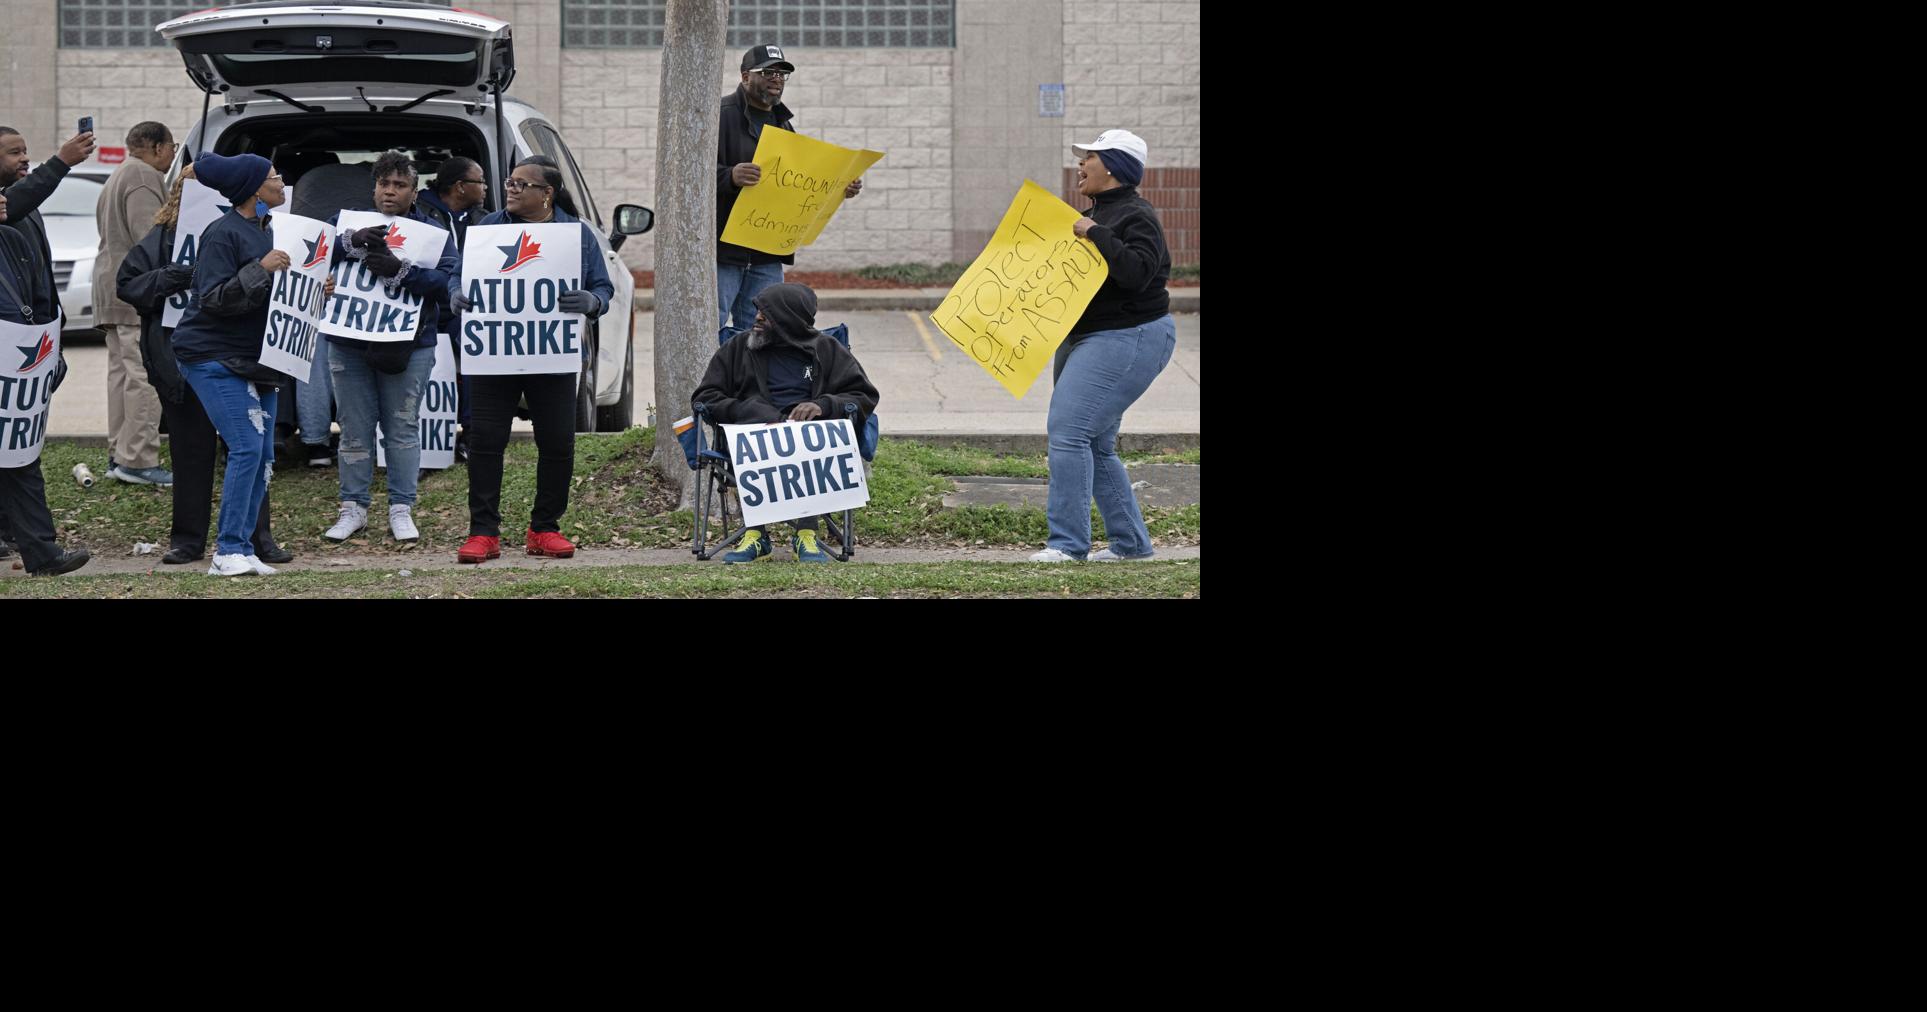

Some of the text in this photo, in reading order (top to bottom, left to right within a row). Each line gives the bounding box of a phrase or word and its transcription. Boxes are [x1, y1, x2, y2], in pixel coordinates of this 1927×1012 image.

[273, 269, 315, 312] ATU
[467, 278, 525, 314] ATU
[320, 293, 417, 333] TRIKE
[266, 310, 319, 362] STRIKE
[464, 319, 578, 356] STRIKE
[0, 375, 39, 411] TU
[426, 380, 456, 413] ON
[0, 413, 45, 450] TRIK
[421, 418, 455, 450] IKE
[736, 421, 851, 465] ATU ON
[739, 453, 860, 507] STRIKE
